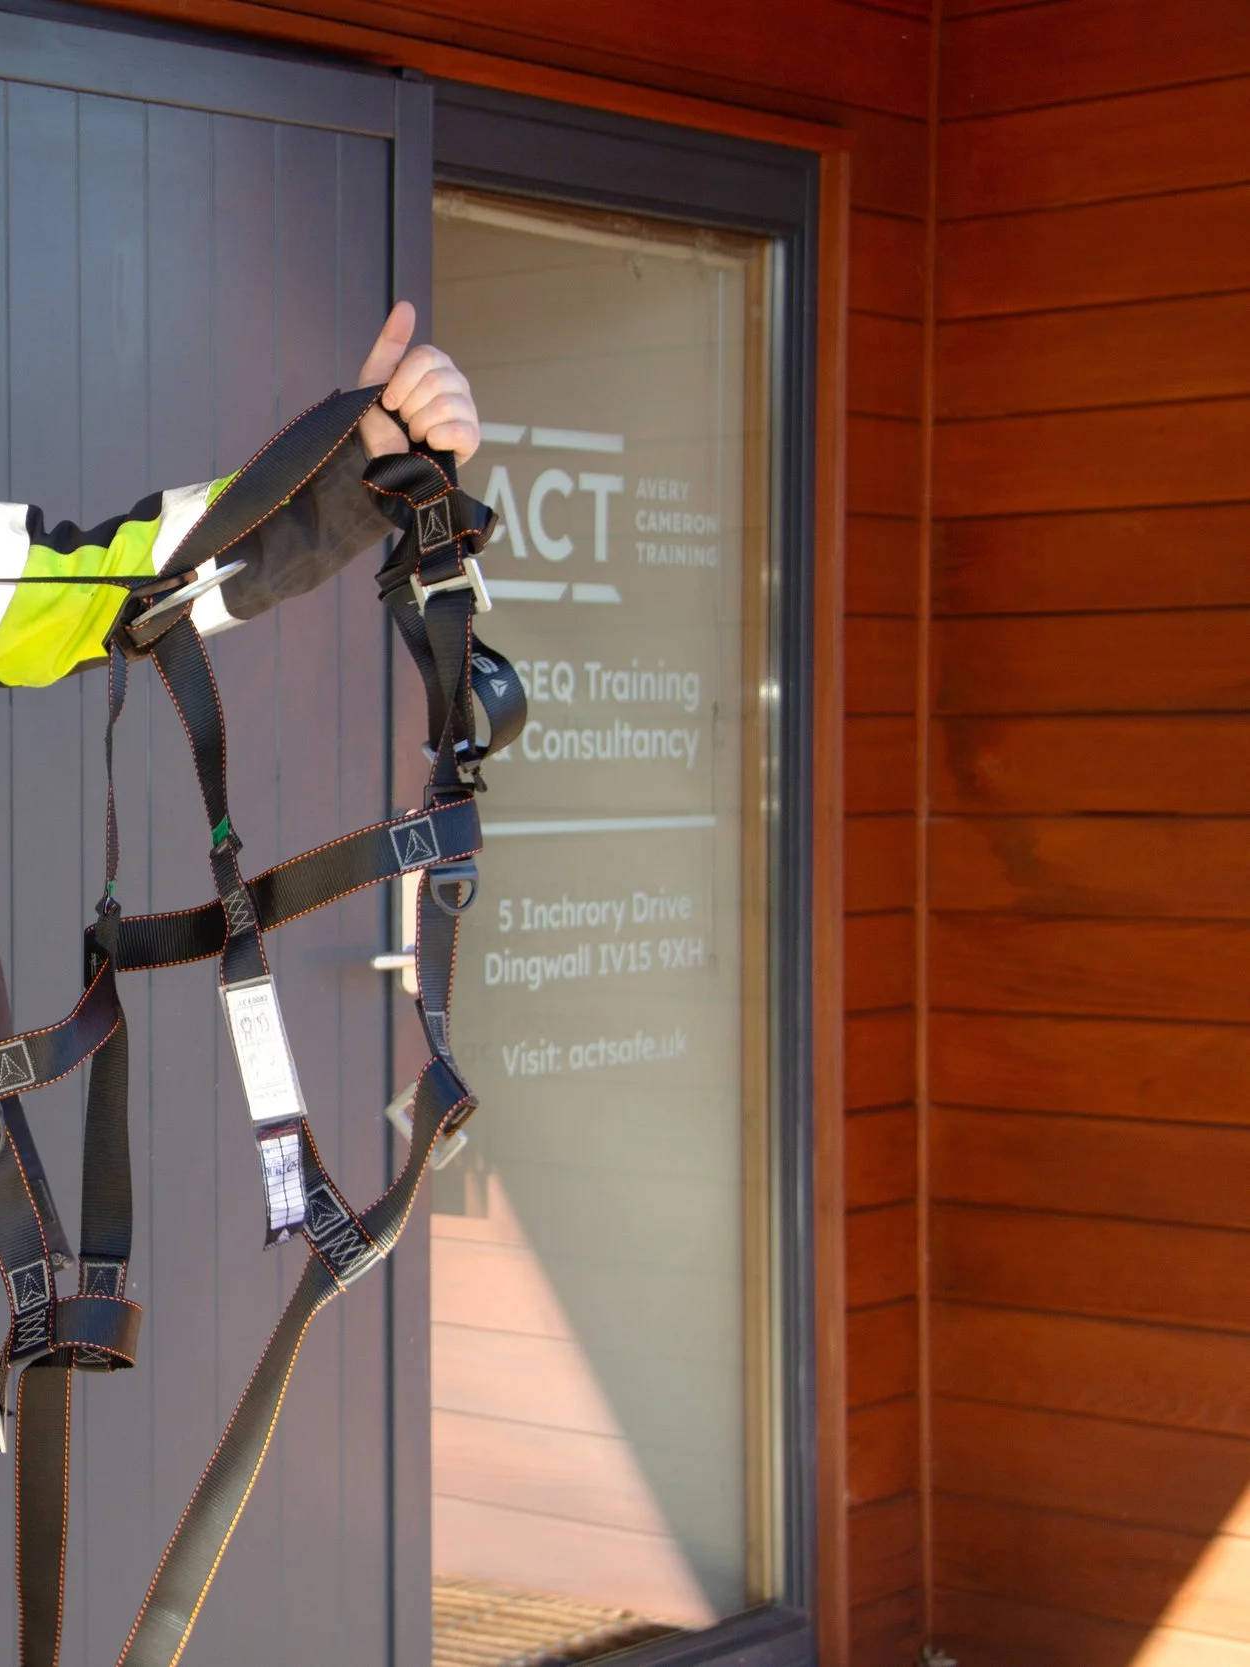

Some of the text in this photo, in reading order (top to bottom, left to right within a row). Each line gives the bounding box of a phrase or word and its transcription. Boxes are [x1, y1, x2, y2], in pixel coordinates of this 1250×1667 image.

[483, 465, 624, 562] ACT
[635, 478, 690, 501] AVERY
[634, 510, 720, 534] CAMERON
[634, 543, 719, 568] TRAINING
[516, 661, 575, 705] SEQ
[584, 659, 700, 712] Training
[521, 718, 699, 770] Consultancy
[498, 886, 693, 933] 5 Inchrory Drive
[484, 937, 705, 991] Dingwall IV15 9XH
[502, 1026, 688, 1077] Visit: actsafe.uk
